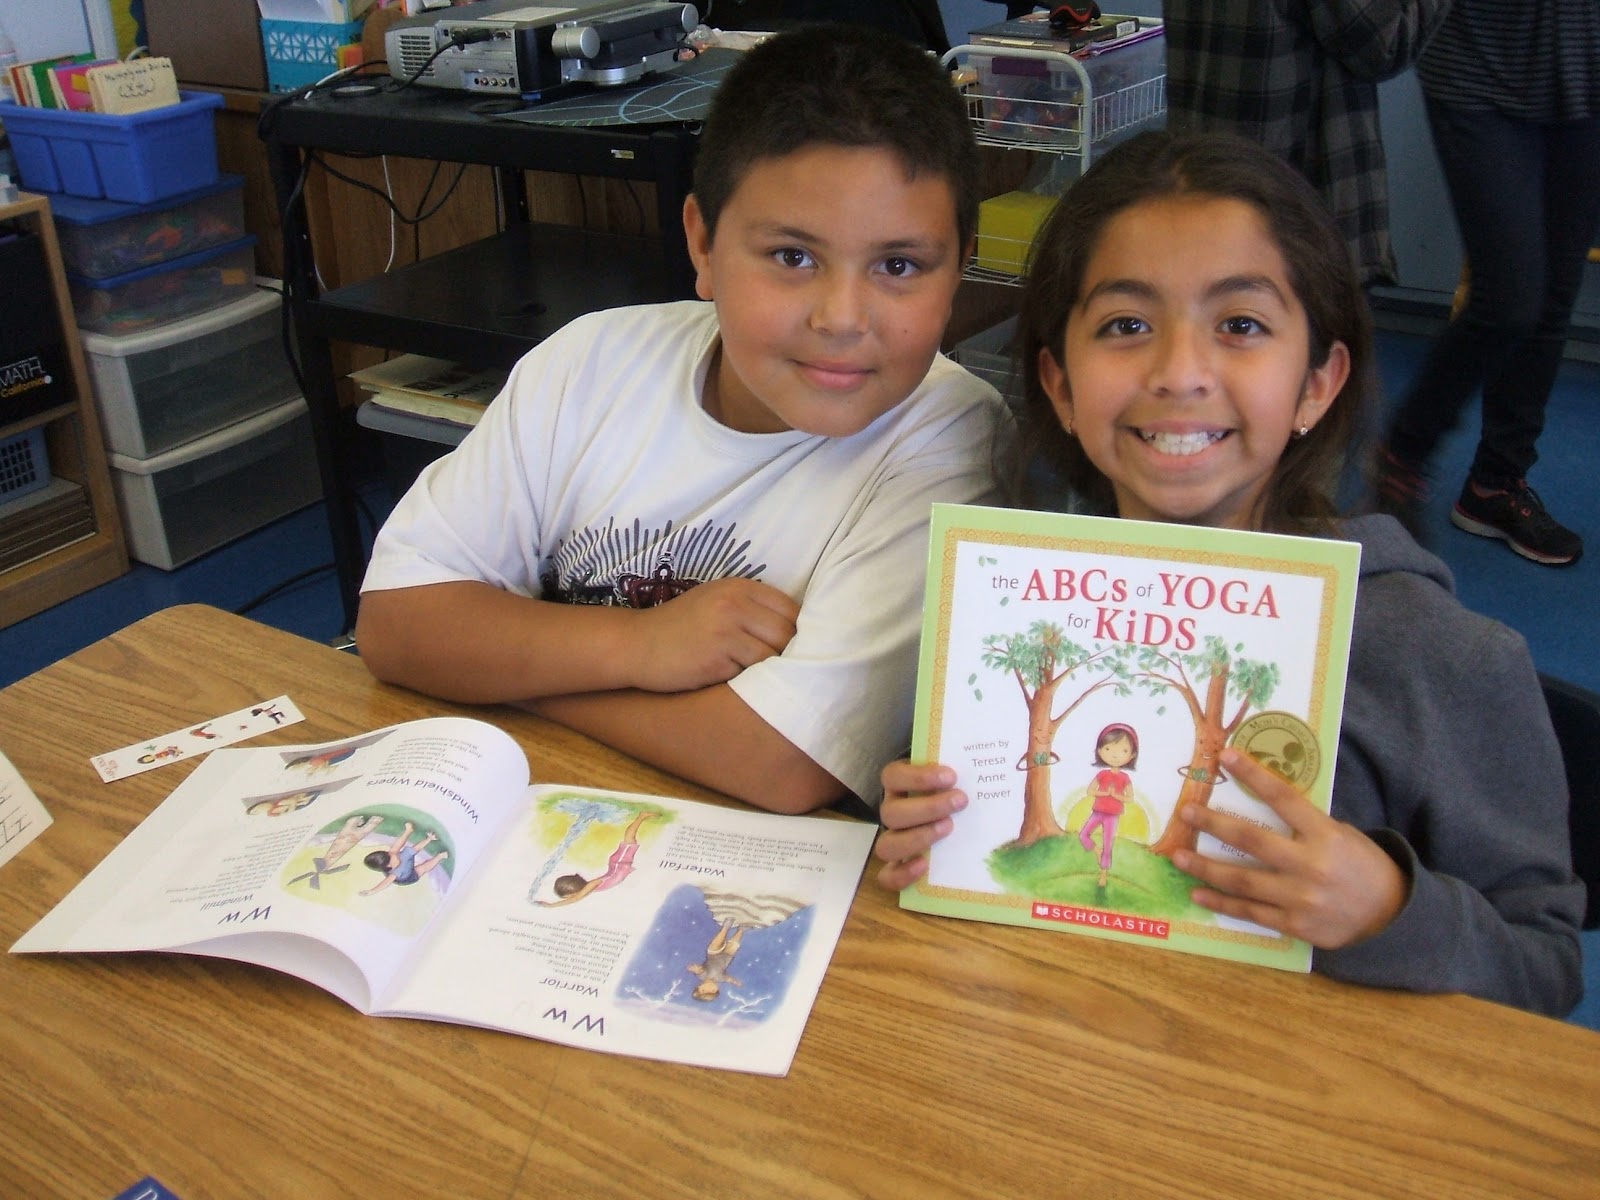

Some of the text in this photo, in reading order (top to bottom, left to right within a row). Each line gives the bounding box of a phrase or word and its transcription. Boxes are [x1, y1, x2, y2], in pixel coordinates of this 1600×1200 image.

[992, 568, 1281, 619] the ABCs of YOGA
[1067, 612, 1092, 629] for
[963, 740, 1010, 752] written by
[972, 757, 1006, 767] Teresa
[977, 774, 1006, 783] Anne
[366, 776, 478, 824] Windshield Wipers
[977, 790, 1011, 800] Power
[658, 859, 725, 878] Waterfall
[200, 894, 253, 911] Windmill
[240, 906, 272, 923] W
[1051, 908, 1167, 936] SCHOLASTIC
[539, 978, 598, 998] Warrior
[572, 1015, 604, 1036] W
